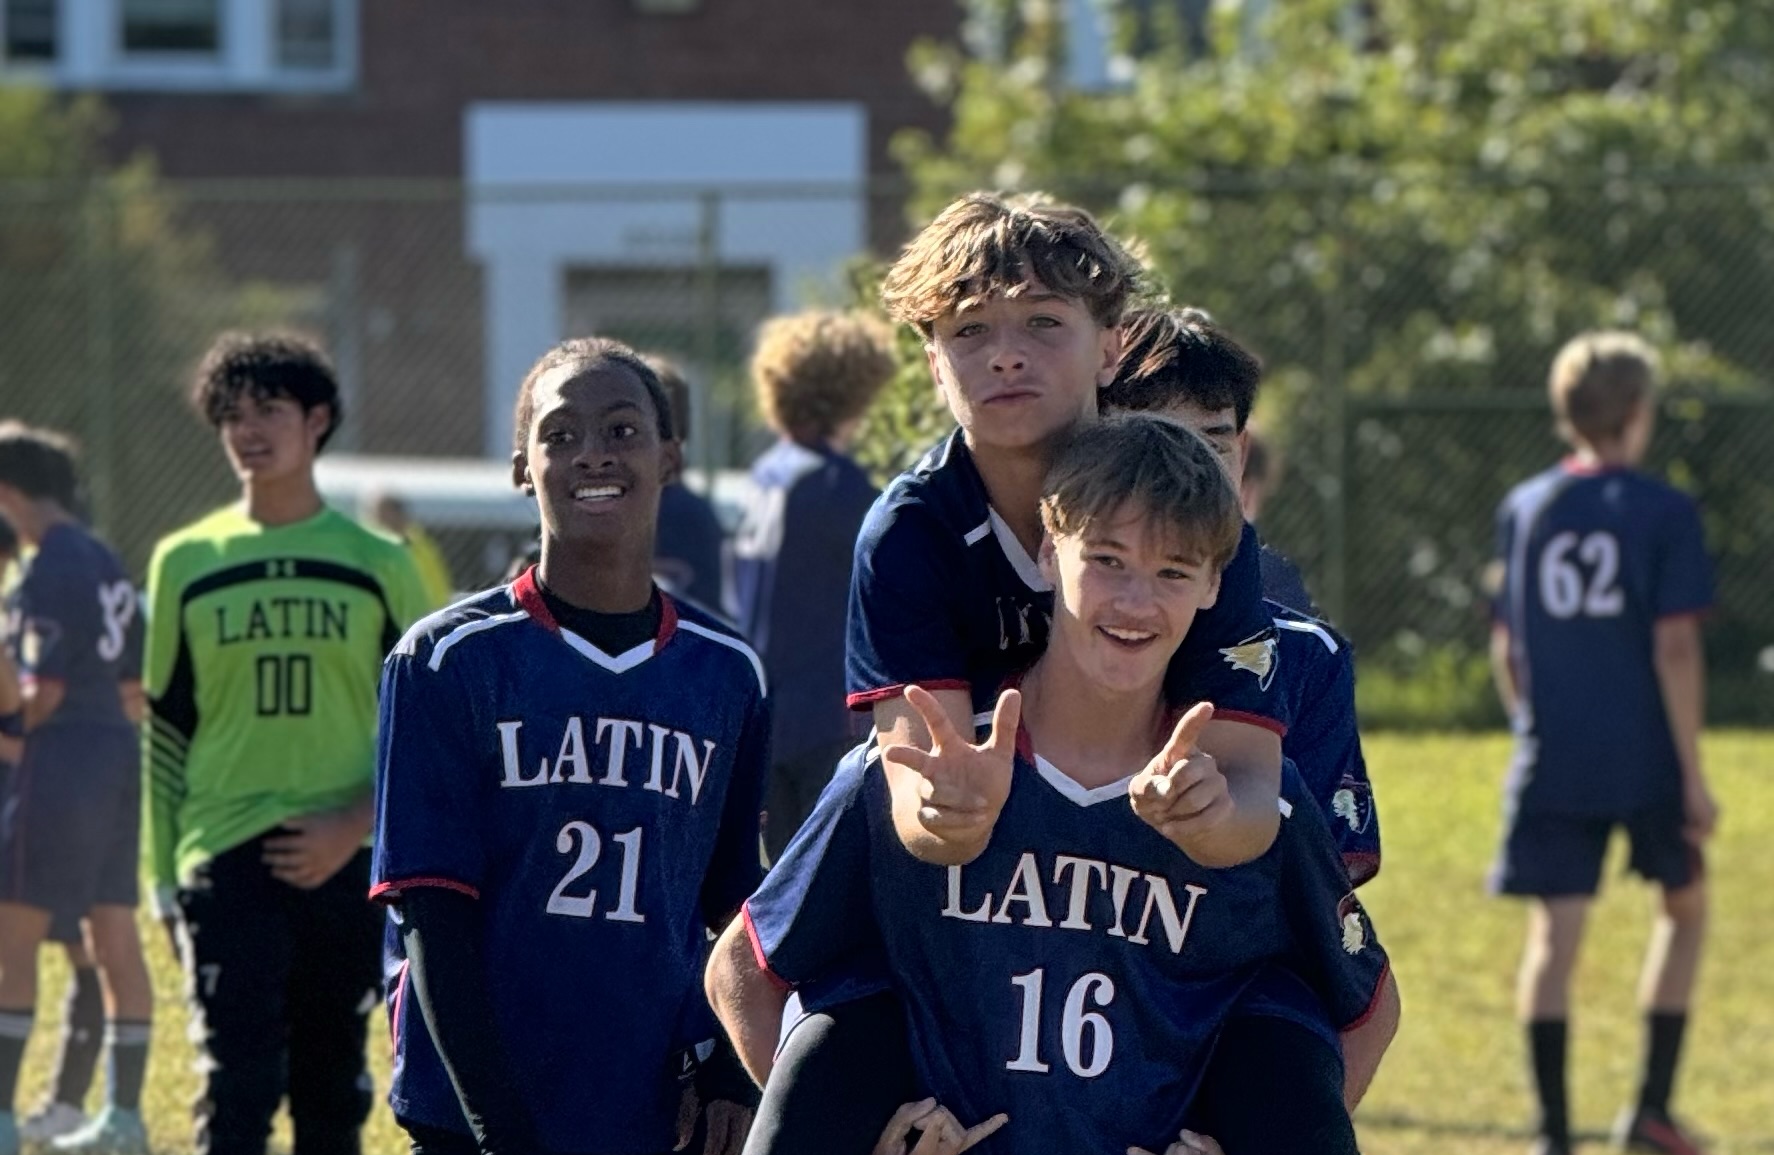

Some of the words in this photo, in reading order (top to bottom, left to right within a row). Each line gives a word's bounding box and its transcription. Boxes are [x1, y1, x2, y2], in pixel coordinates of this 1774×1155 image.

[1540, 530, 1624, 618] 62
[215, 598, 348, 646] LATIN
[256, 654, 311, 717] 00
[496, 716, 716, 806] LATIN
[546, 820, 645, 923] 21
[941, 852, 1208, 954] LATIN
[1005, 968, 1115, 1078] 16
